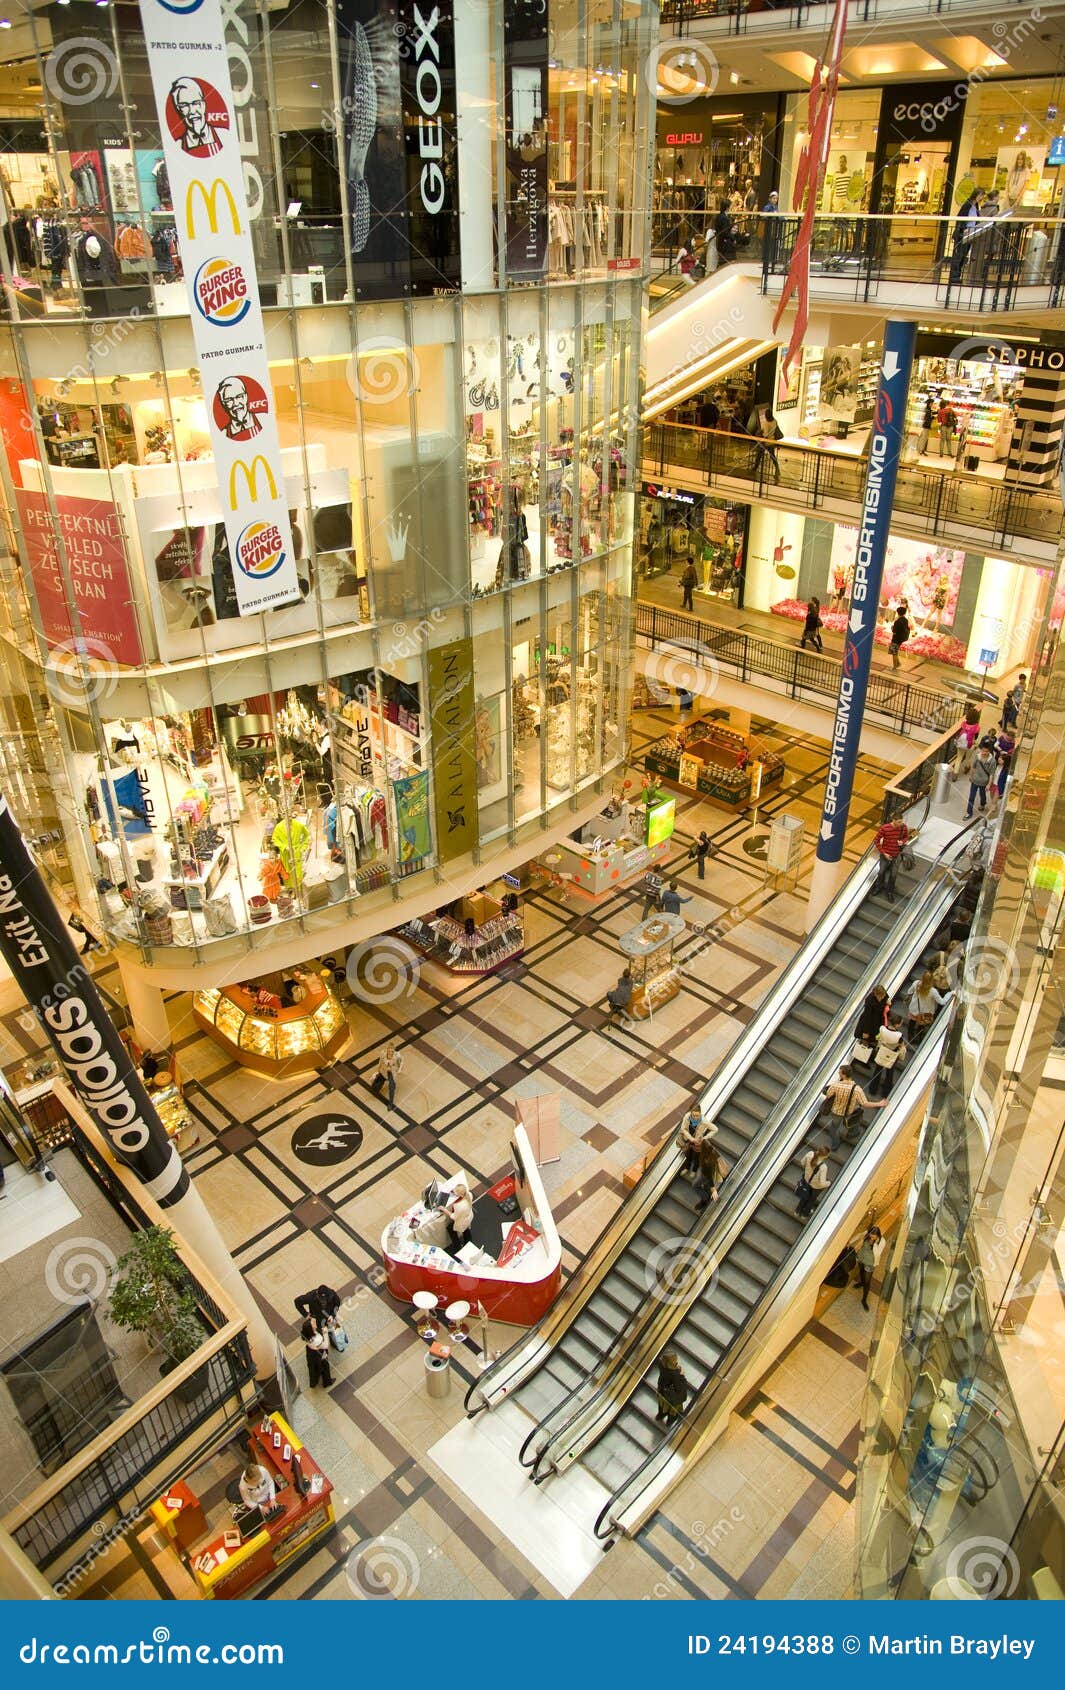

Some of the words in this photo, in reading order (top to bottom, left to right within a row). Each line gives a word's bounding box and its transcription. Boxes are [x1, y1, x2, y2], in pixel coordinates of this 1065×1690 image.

[207, 112, 228, 122] KFC
[414, 3, 444, 214] GEOX
[666, 132, 703, 145] GURU
[199, 266, 243, 298] BURGER
[203, 278, 247, 316] KING
[201, 349, 224, 360] PATRO
[249, 399, 268, 410] KFC
[852, 434, 888, 602] SPORTISIMO
[240, 525, 279, 557] BURGER
[244, 536, 283, 572] KING
[54, 576, 106, 600] SRAN
[824, 678, 854, 816] SPORTISIMO
[5, 914, 50, 969] Exit
[45, 996, 149, 1153] adidas
